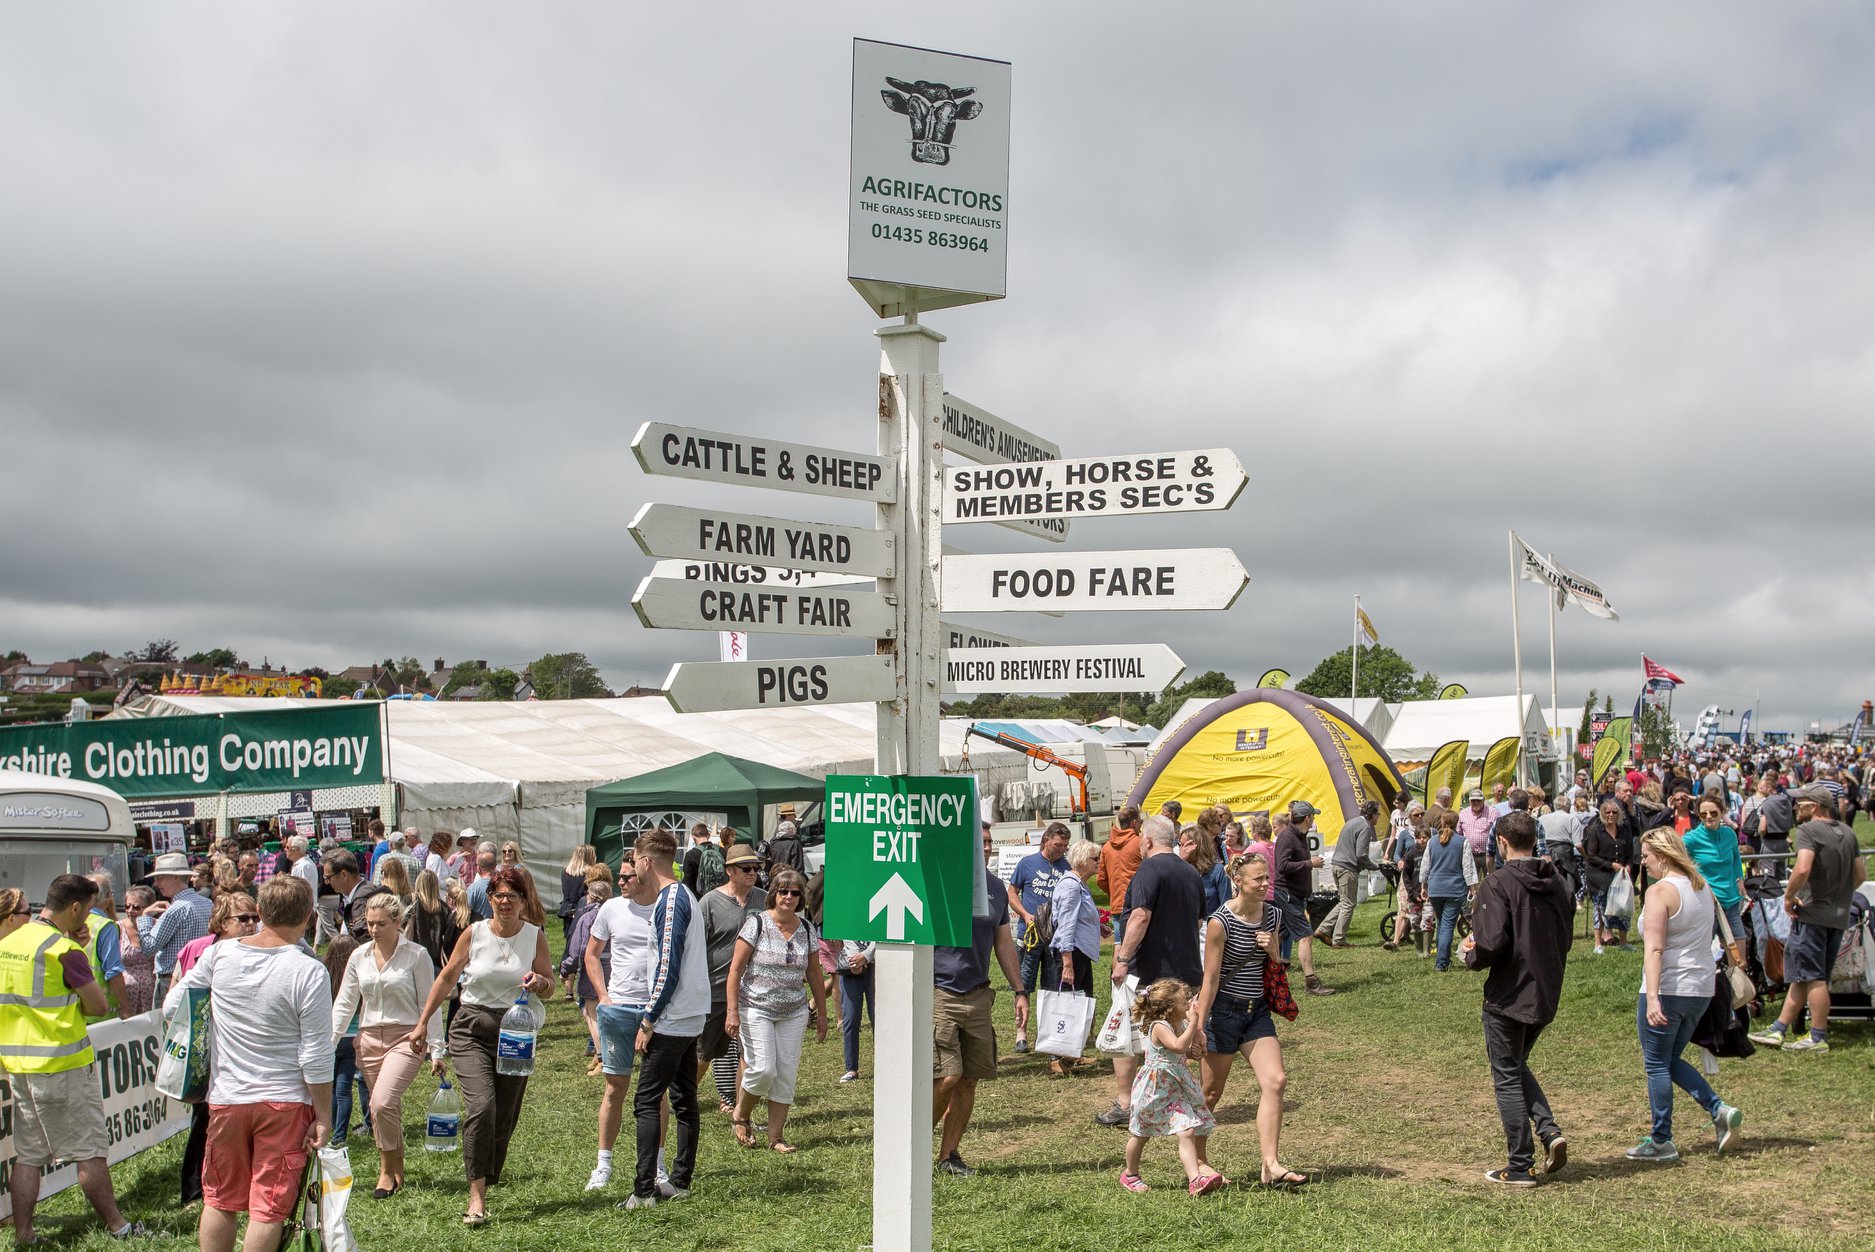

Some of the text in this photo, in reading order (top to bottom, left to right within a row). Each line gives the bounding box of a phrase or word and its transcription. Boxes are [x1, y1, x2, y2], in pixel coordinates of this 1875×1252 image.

[861, 175, 1002, 212] AGRIFACTORS
[860, 201, 1001, 230] THE GRASS SEED SPECIALISTS
[871, 223, 988, 253] 01435 863964
[662, 433, 882, 491] CATTLE & SHEEP
[954, 455, 1213, 492] SHOW, HORSE &
[955, 482, 1215, 518] MEMBERS SEC'S
[700, 519, 851, 564] FARM YARD
[992, 566, 1176, 598] FOOD FARE
[700, 590, 851, 628] CRAFT FAIR
[757, 665, 828, 704] PIGS
[947, 658, 1145, 682] MICRO BREWERY FESTIVAL
[1592, 722, 1608, 730] SOL
[85, 738, 210, 783] Clothing
[220, 733, 369, 778] Company
[4, 806, 83, 818] Mister Softee
[131, 809, 180, 818] aleclothing.co.uk
[831, 792, 966, 827] EMERGENCY
[1206, 796, 1218, 804] No
[1220, 796, 1240, 804] more
[1394, 818, 1408, 827] NYC
[171, 837, 184, 847] £35
[873, 831, 921, 863] EXIT
[991, 837, 1024, 845] tovewood
